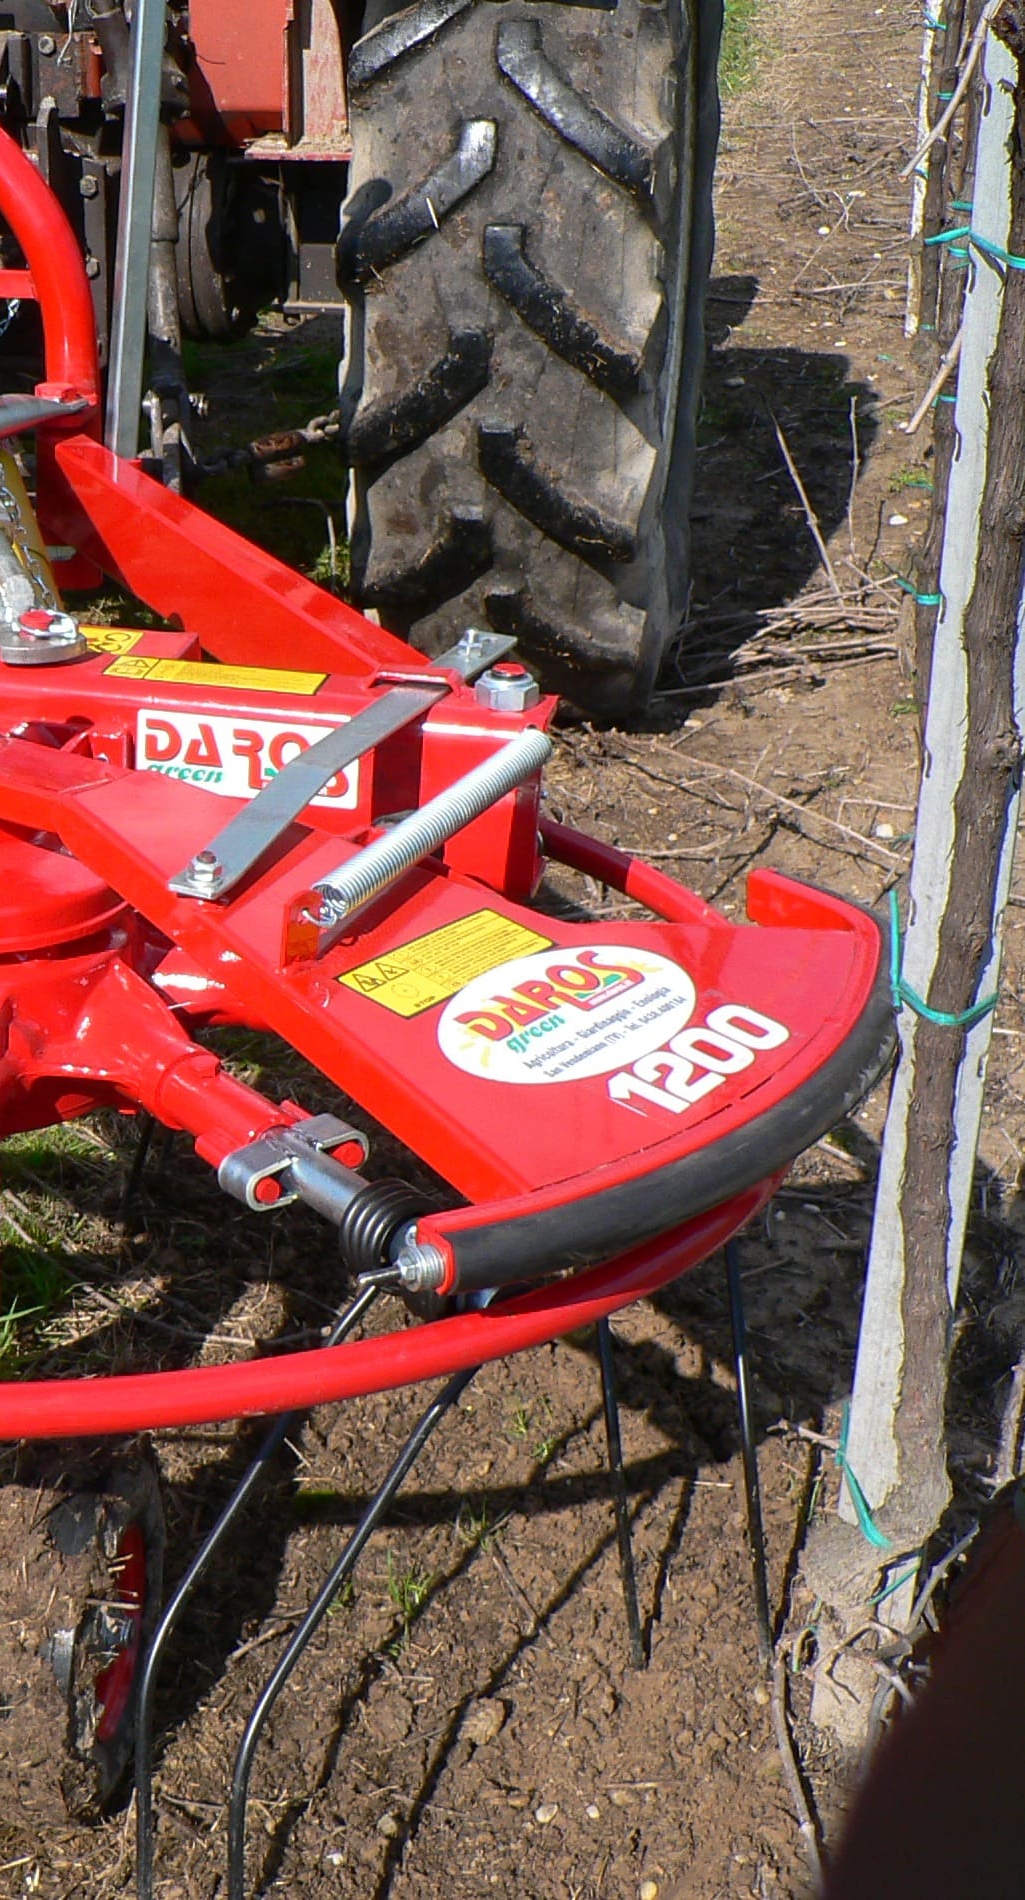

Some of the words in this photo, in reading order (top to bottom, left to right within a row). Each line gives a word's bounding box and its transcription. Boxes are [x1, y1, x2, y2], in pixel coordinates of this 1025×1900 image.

[452, 950, 645, 1041] DAROS
[506, 1013, 566, 1054] green
[606, 1003, 790, 1115] 1200
